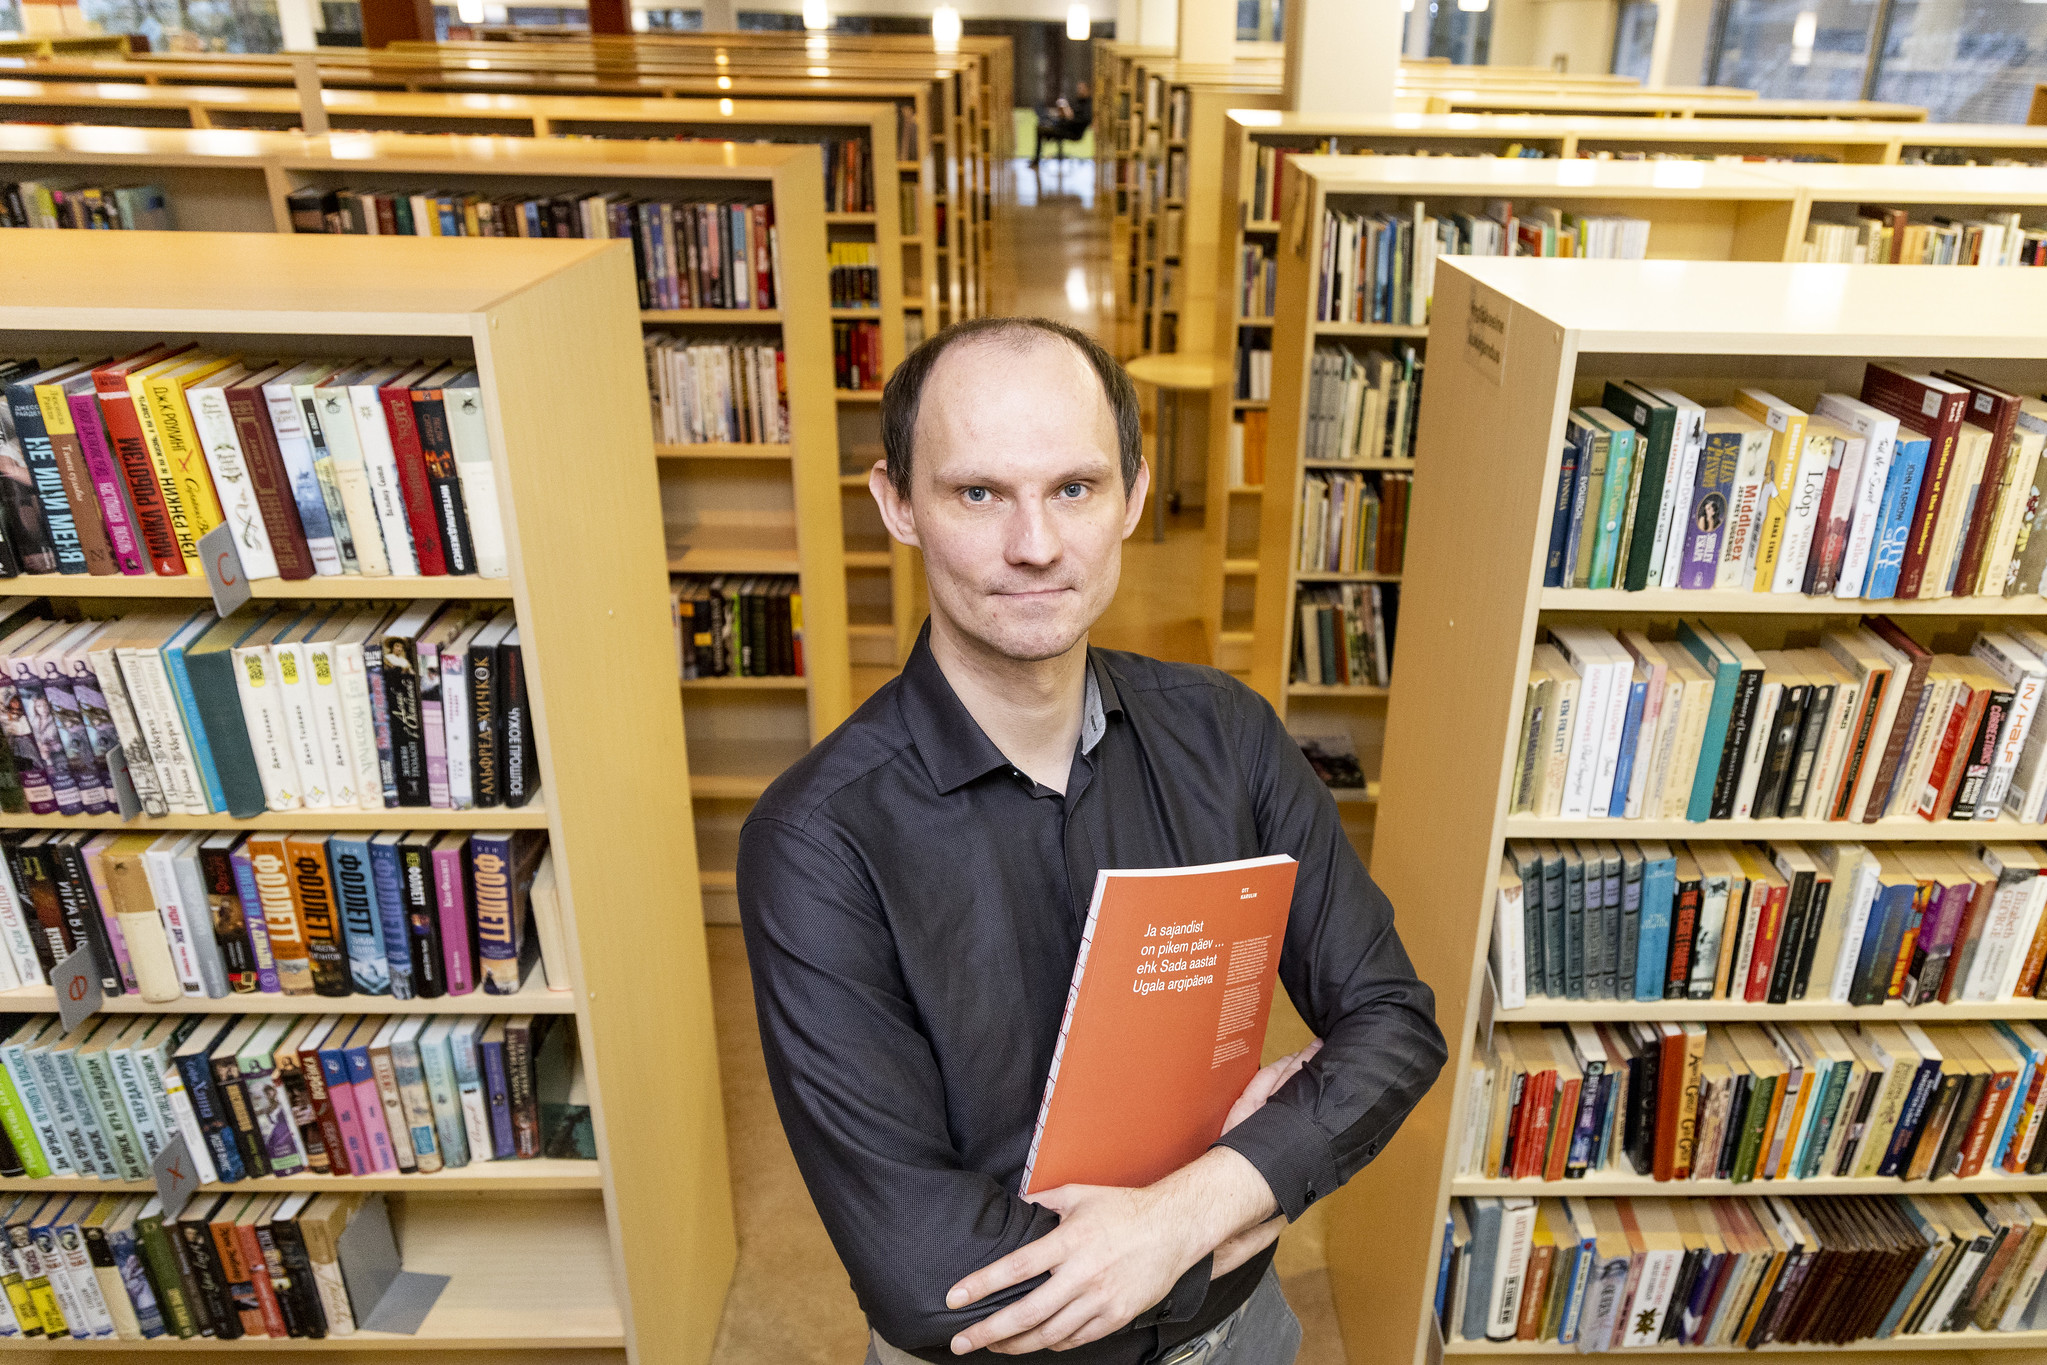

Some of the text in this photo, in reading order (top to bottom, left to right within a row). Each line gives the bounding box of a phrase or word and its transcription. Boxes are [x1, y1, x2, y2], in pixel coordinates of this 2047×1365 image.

[163, 413, 187, 453] РОУЛИНГ
[1780, 461, 1795, 490] PEOPLE
[1936, 436, 1954, 480] Children
[24, 437, 85, 563] НЕ ИЩИ МЕНЯ
[118, 437, 174, 559] МАЙКЛ РОБОТЭМ
[1576, 476, 1589, 520] EVOLUTION
[1796, 471, 1823, 517] Loop
[1896, 463, 1916, 521] JOHN FARROW
[1929, 495, 1939, 510] the
[160, 478, 199, 559] ИЭН РЭНКИН
[1724, 485, 1744, 562] JEFFREY EUGENIDES
[1732, 484, 1759, 562] Middlesex
[1766, 517, 1782, 564] DIANA EVANS
[1850, 511, 1873, 568] Jane Fallon
[1917, 511, 1936, 556] Rainbow
[1878, 537, 1893, 569] ICE
[1888, 526, 1908, 568] CITY
[1743, 686, 1756, 719] Memory
[1749, 672, 1758, 685] The
[474, 655, 496, 795] АЛЬФРЕД ХИЧКОК
[508, 707, 522, 743] ЧУЖОЕ
[1554, 698, 1571, 754] KEN FOLLETT
[1582, 667, 1600, 743] JULIAN FELLOWES
[1607, 666, 1629, 742] JULIAN FELLOWES
[1734, 724, 1746, 746] Love
[1980, 704, 2003, 766] CORRECTIONS
[509, 745, 524, 798] ПРОШЛОЕ
[252, 854, 300, 943] ФОЛЛЕТТ
[295, 857, 335, 946] ФОЛЛЕТТ
[338, 853, 374, 936] ФОЛЛЕТТ
[373, 859, 407, 947] ФОЛЛЕТТ
[408, 866, 426, 906] ФОЛЛЕТТ
[474, 853, 512, 944] ФОЛЛЕТТ
[1144, 920, 1204, 938] Ja sajandist
[1990, 889, 2014, 939] GEORGE
[2003, 890, 2029, 939] Elizabeth
[1137, 954, 1217, 975] ehk Sada aastat
[1141, 945, 1156, 957] on
[1158, 941, 1189, 960] pikem
[1191, 938, 1214, 954] päev
[1133, 973, 1213, 997] Ugala argipäeva
